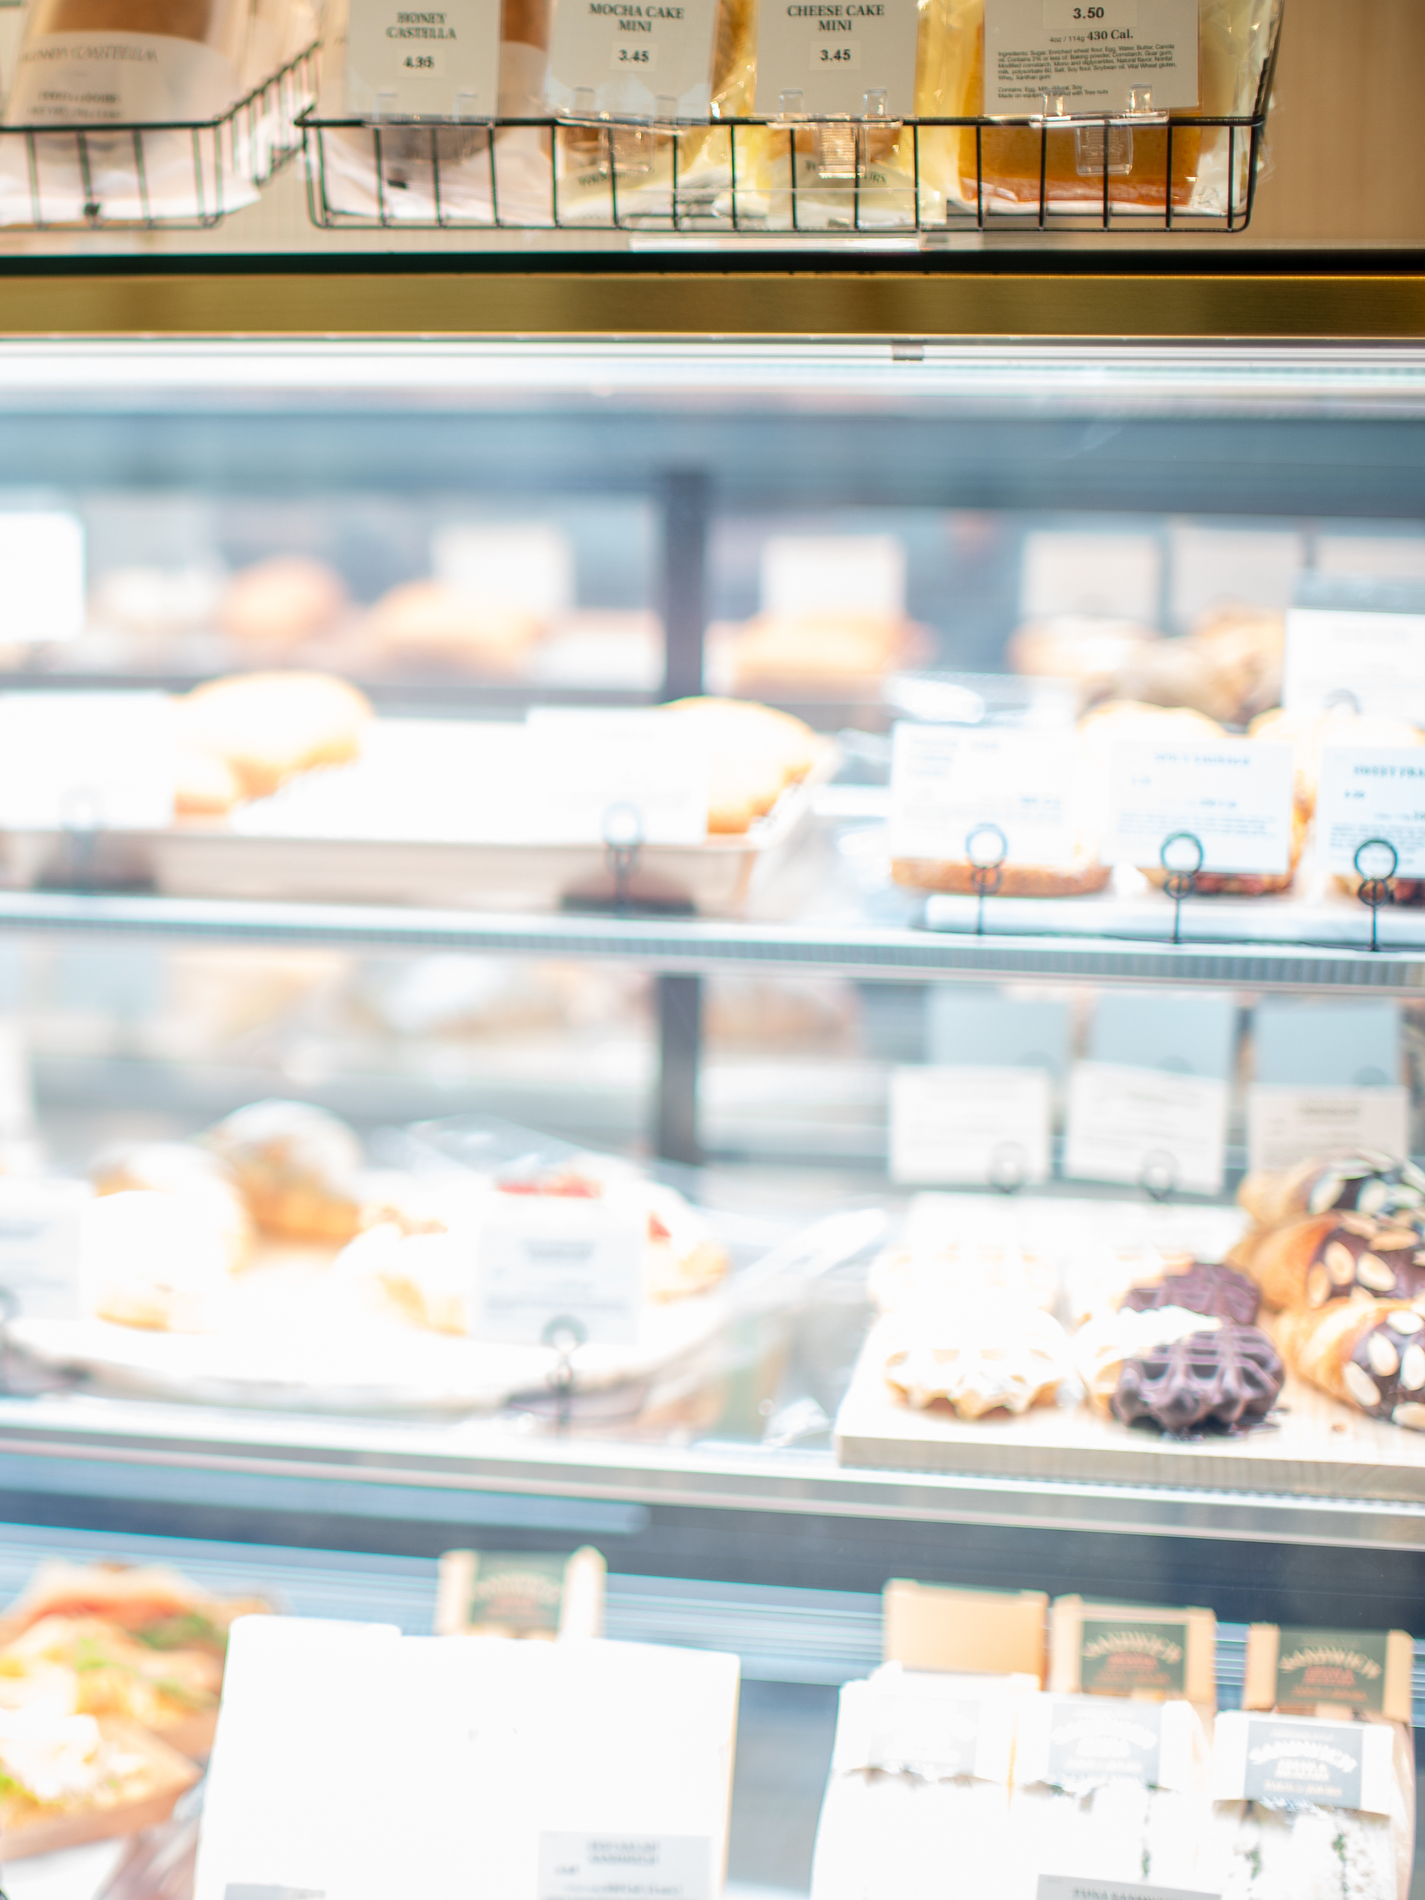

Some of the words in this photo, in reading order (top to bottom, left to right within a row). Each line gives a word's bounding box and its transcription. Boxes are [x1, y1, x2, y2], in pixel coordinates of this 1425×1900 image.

[588, 3, 642, 17] MOCHA
[645, 6, 684, 19] CAKE
[787, 5, 843, 16] CHEESE
[846, 4, 884, 16] CAKE
[1073, 7, 1105, 19] 3.50
[397, 12, 447, 24] HONEY
[617, 19, 651, 32] MINI
[818, 20, 852, 31] MINI
[386, 26, 457, 39] CASTELLA
[1087, 30, 1108, 40] 430
[1111, 28, 1134, 39] Cal.
[618, 49, 649, 62] 3.45
[820, 49, 850, 61] 3.45
